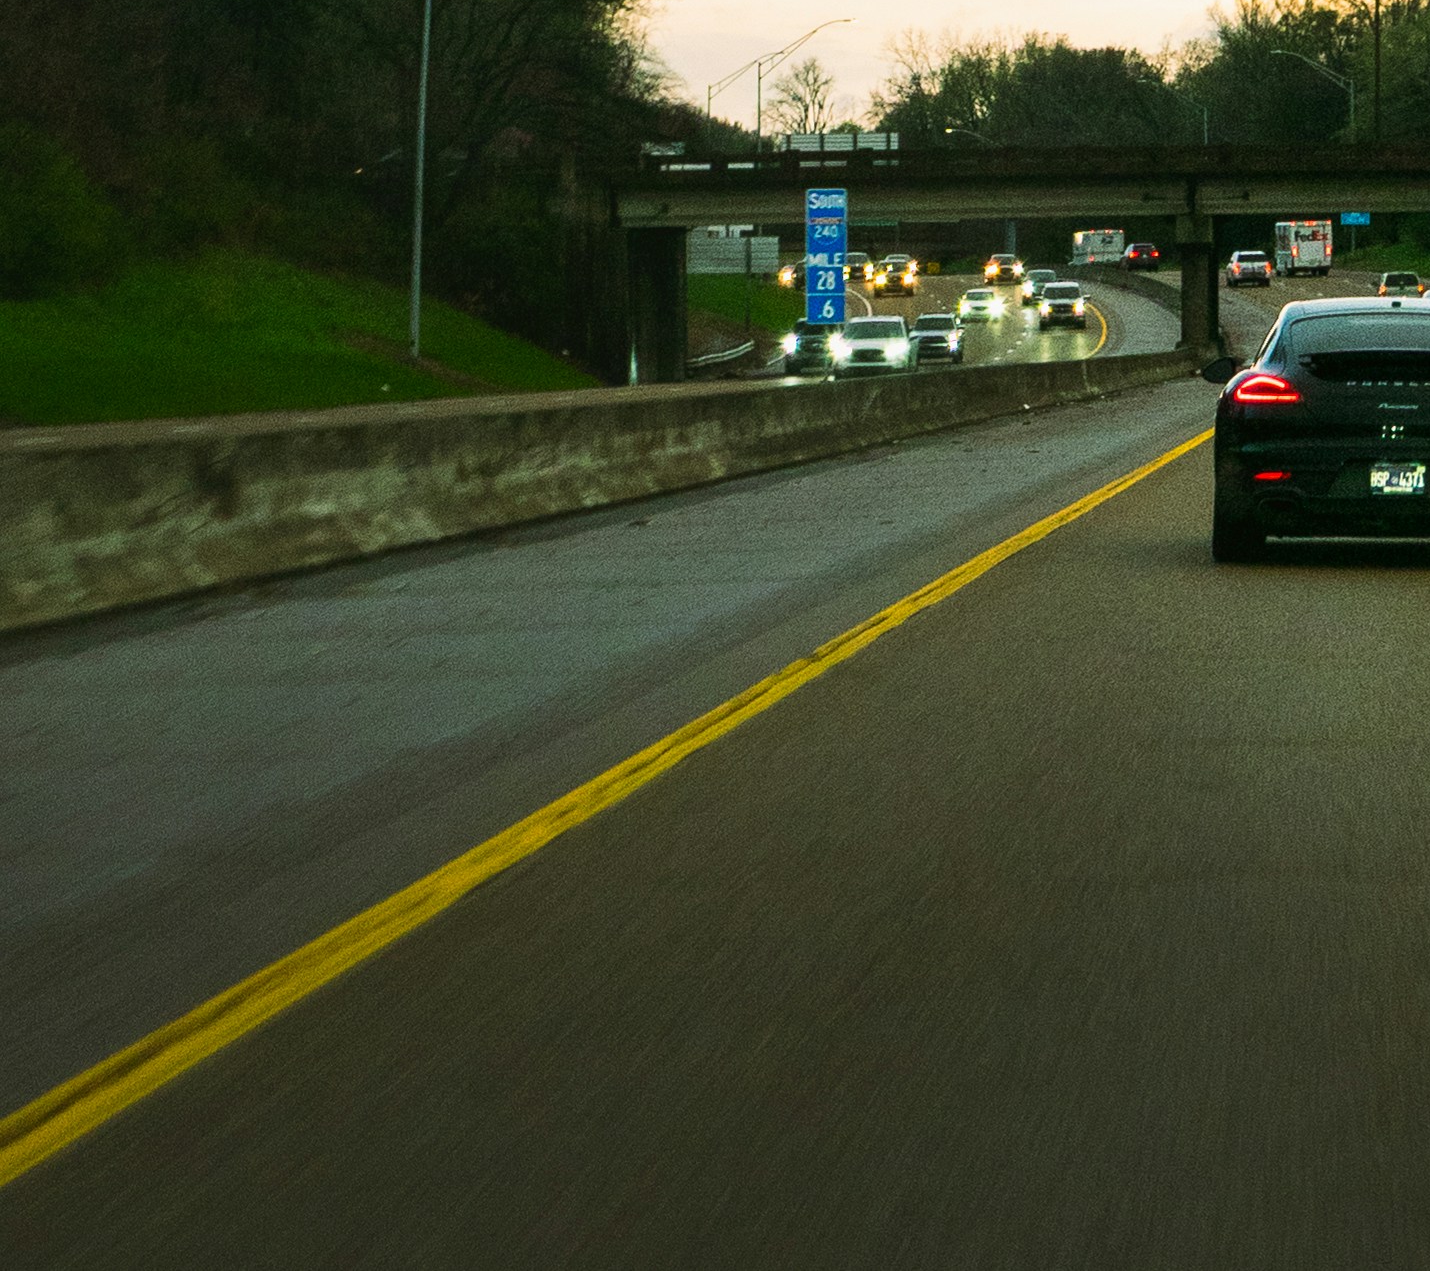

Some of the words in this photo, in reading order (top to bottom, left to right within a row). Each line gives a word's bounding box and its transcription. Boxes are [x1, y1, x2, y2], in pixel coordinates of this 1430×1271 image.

[815, 224, 839, 238] 240
[1295, 230, 1328, 242] FedEx
[808, 252, 844, 267] MILE
[817, 270, 836, 291] 28
